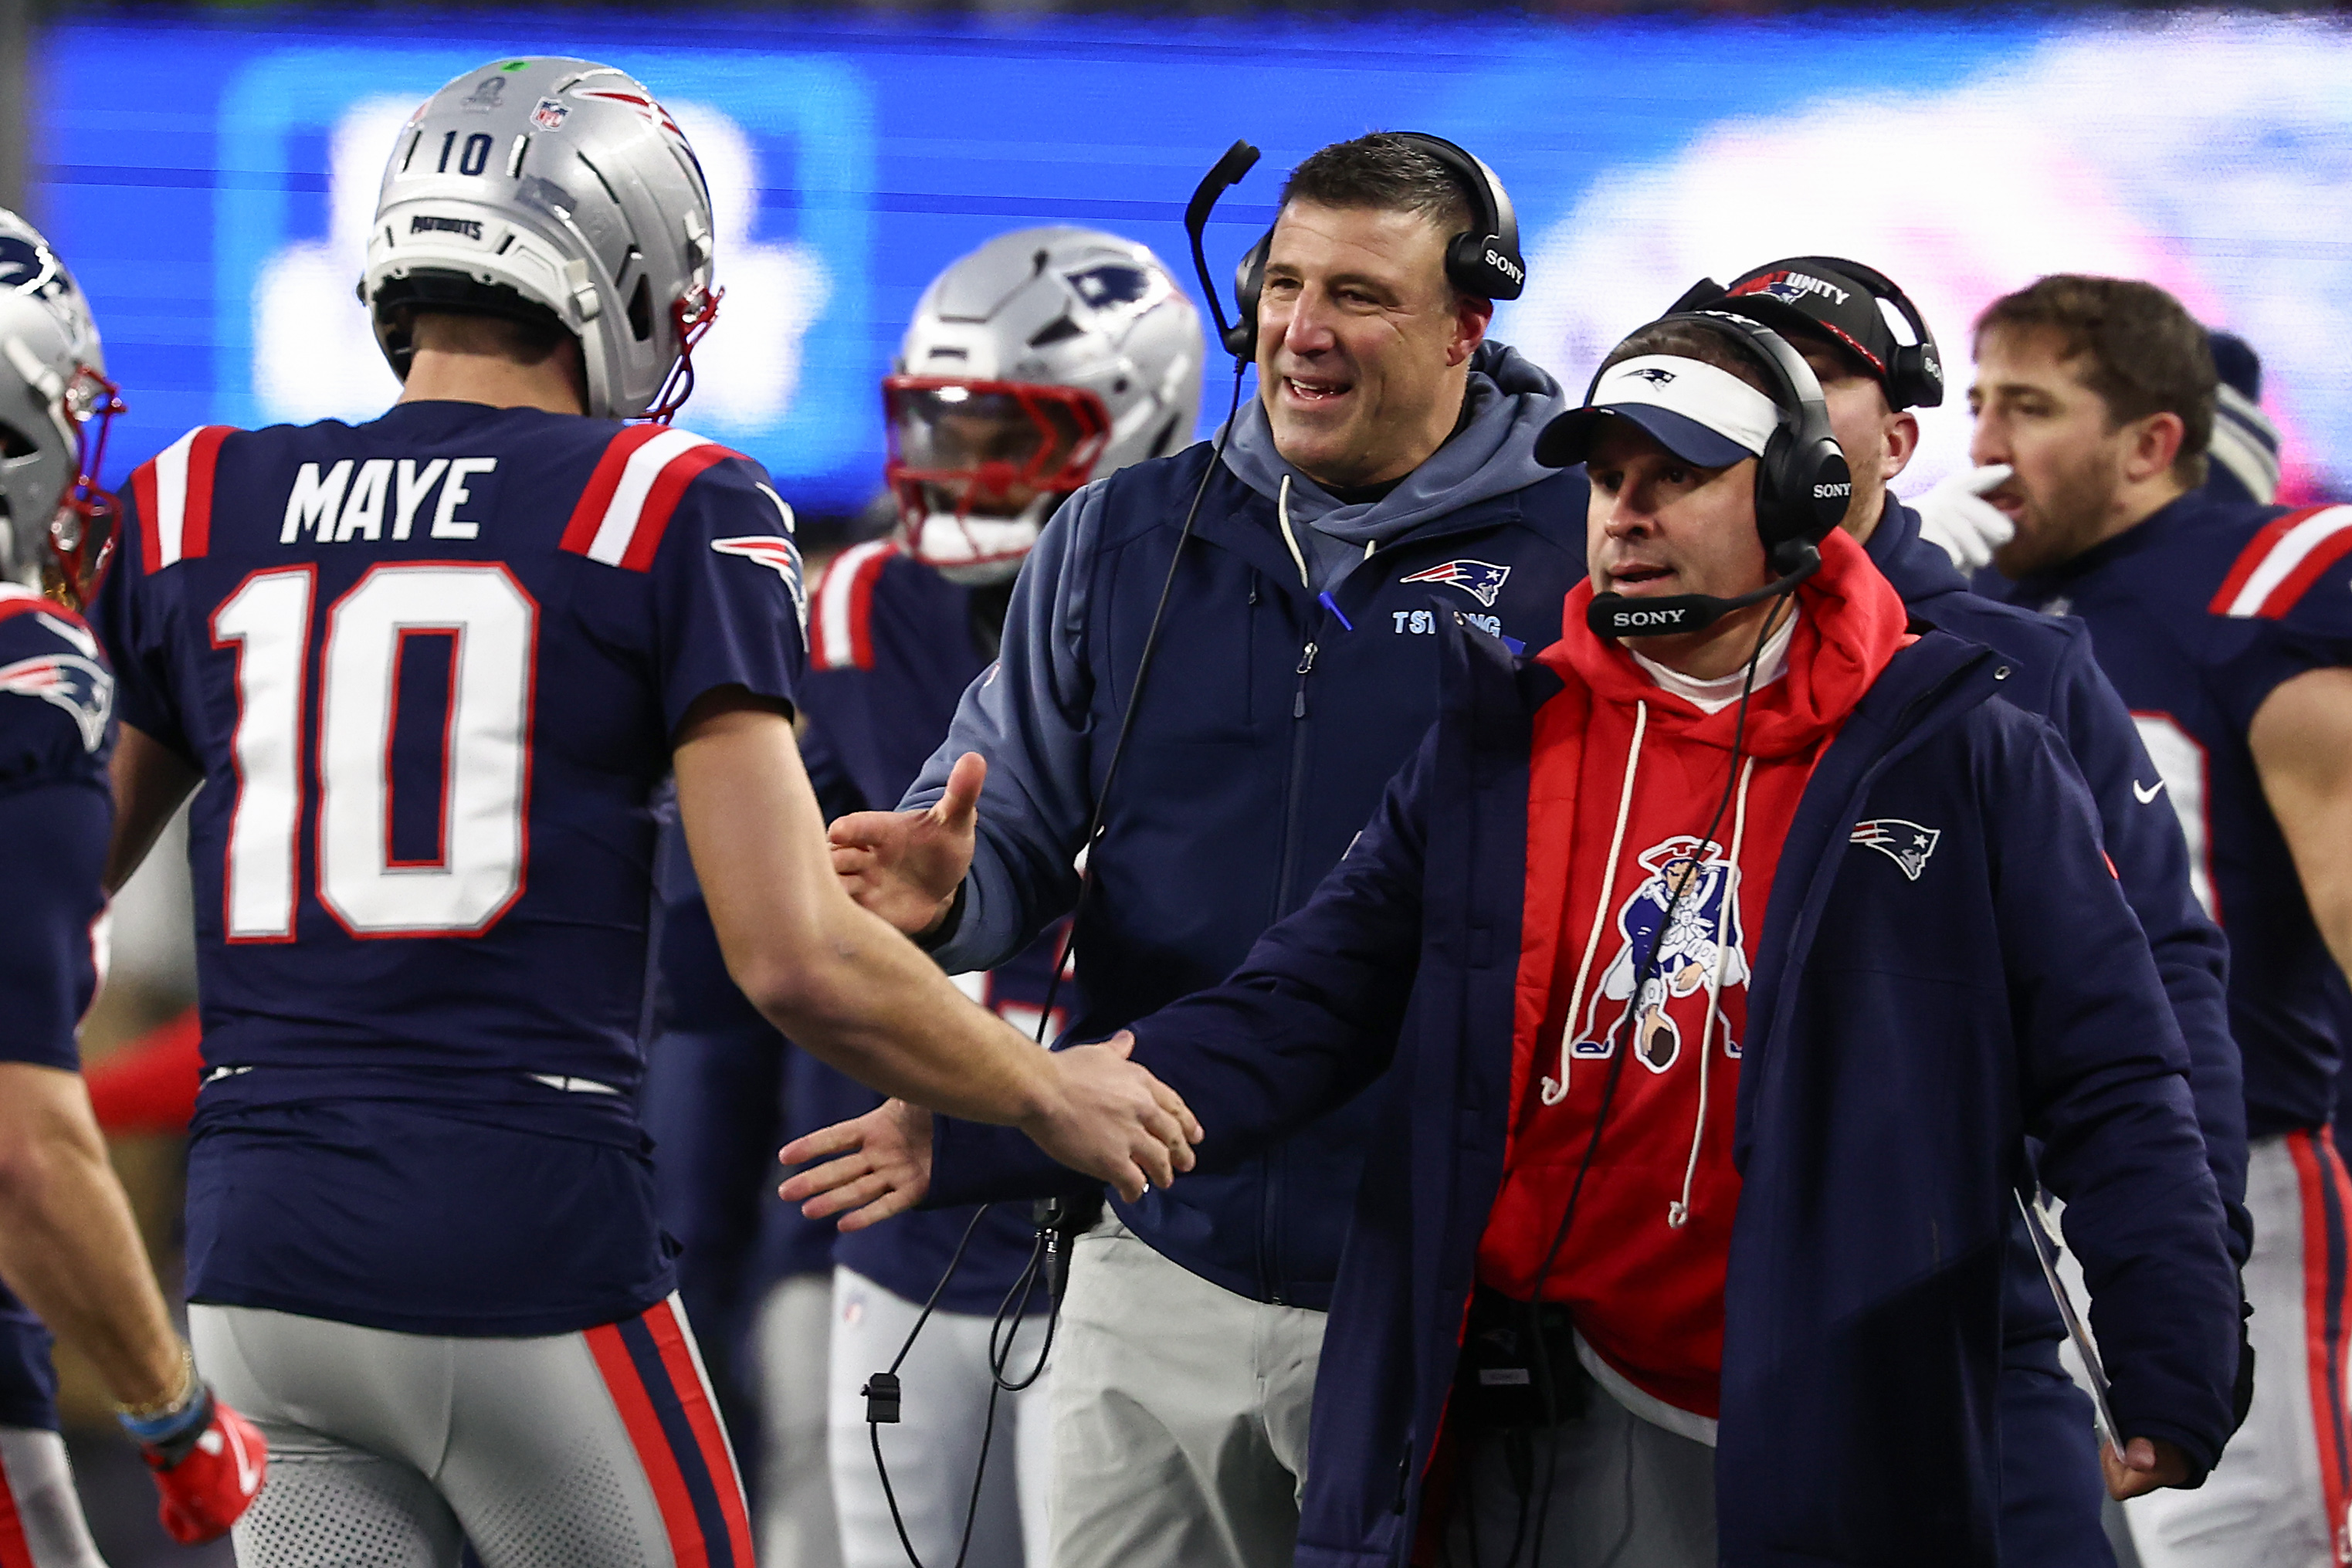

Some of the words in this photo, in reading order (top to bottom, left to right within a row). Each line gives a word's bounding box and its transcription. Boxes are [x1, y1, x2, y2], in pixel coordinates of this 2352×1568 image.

[439, 130, 493, 176] 10
[1484, 249, 1525, 285] SONY
[1785, 272, 1850, 305] UNITY
[280, 457, 497, 544] MAYE
[1813, 483, 1852, 499] SONY
[1392, 610, 1501, 638] TSTNG
[1613, 609, 1686, 627] SONY
[208, 560, 540, 945] 10
